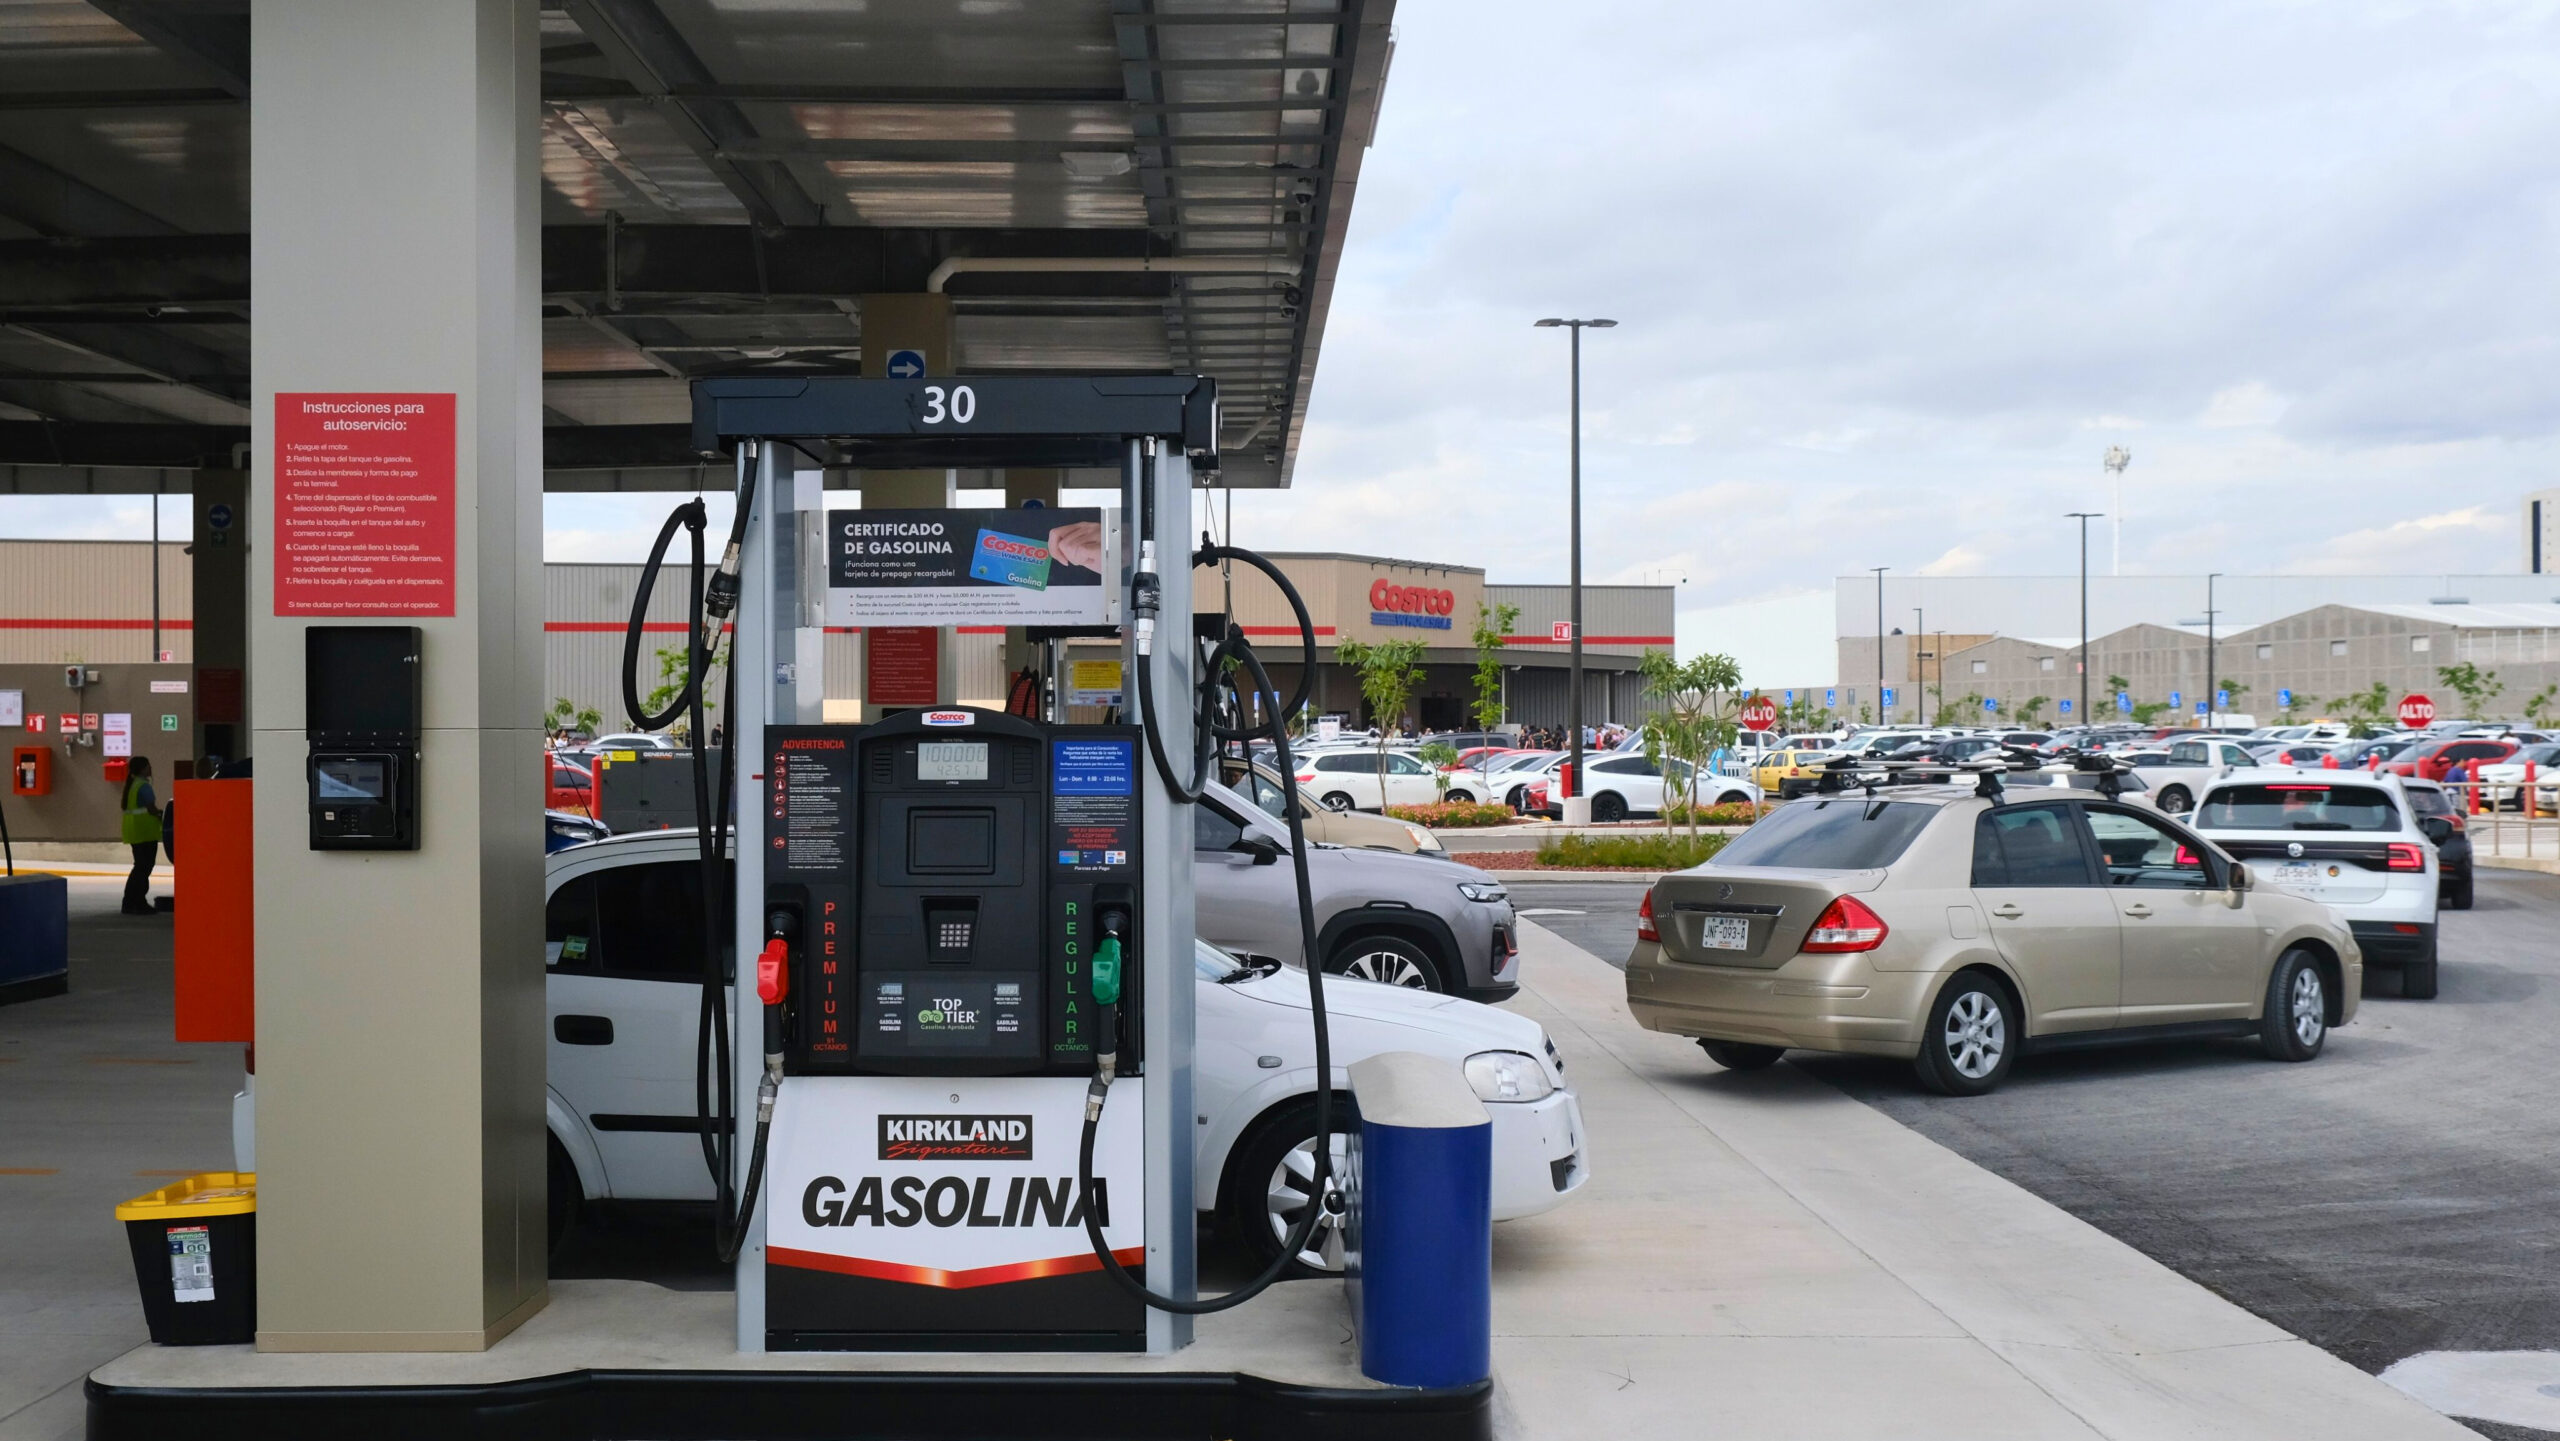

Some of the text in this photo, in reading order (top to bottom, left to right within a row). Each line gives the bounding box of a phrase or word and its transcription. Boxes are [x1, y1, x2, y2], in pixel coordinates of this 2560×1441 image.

[303, 402, 424, 416] Instrucciones para
[923, 386, 975, 424] 30
[323, 420, 407, 431] autoservicio:
[844, 523, 944, 536] CERTIFICADO
[845, 542, 952, 554] DE GASOLINA
[983, 535, 1048, 559] COSTCO
[1001, 552, 1044, 565] WHOLESALE
[845, 571, 868, 579] tarjeta
[882, 571, 912, 579] prepago
[914, 569, 955, 578] recargable!
[1008, 573, 1042, 586] Gasolina
[1370, 578, 1454, 615] COSTCO
[1395, 614, 1451, 630] WHOLESALE
[1743, 706, 1774, 720] ALTO
[2400, 704, 2433, 719] ALTO
[783, 740, 845, 749] ADVERTENCIA
[1705, 925, 1745, 940] JNF-093-A
[824, 902, 837, 1033] PREMIUM
[1066, 902, 1077, 1033] REGULAR
[933, 999, 962, 1010] TOP
[944, 1012, 974, 1023] TIER
[887, 1120, 1026, 1141] KIRKLAND
[887, 1141, 1026, 1161] Signature
[802, 1176, 1110, 1227] GASOLINA
